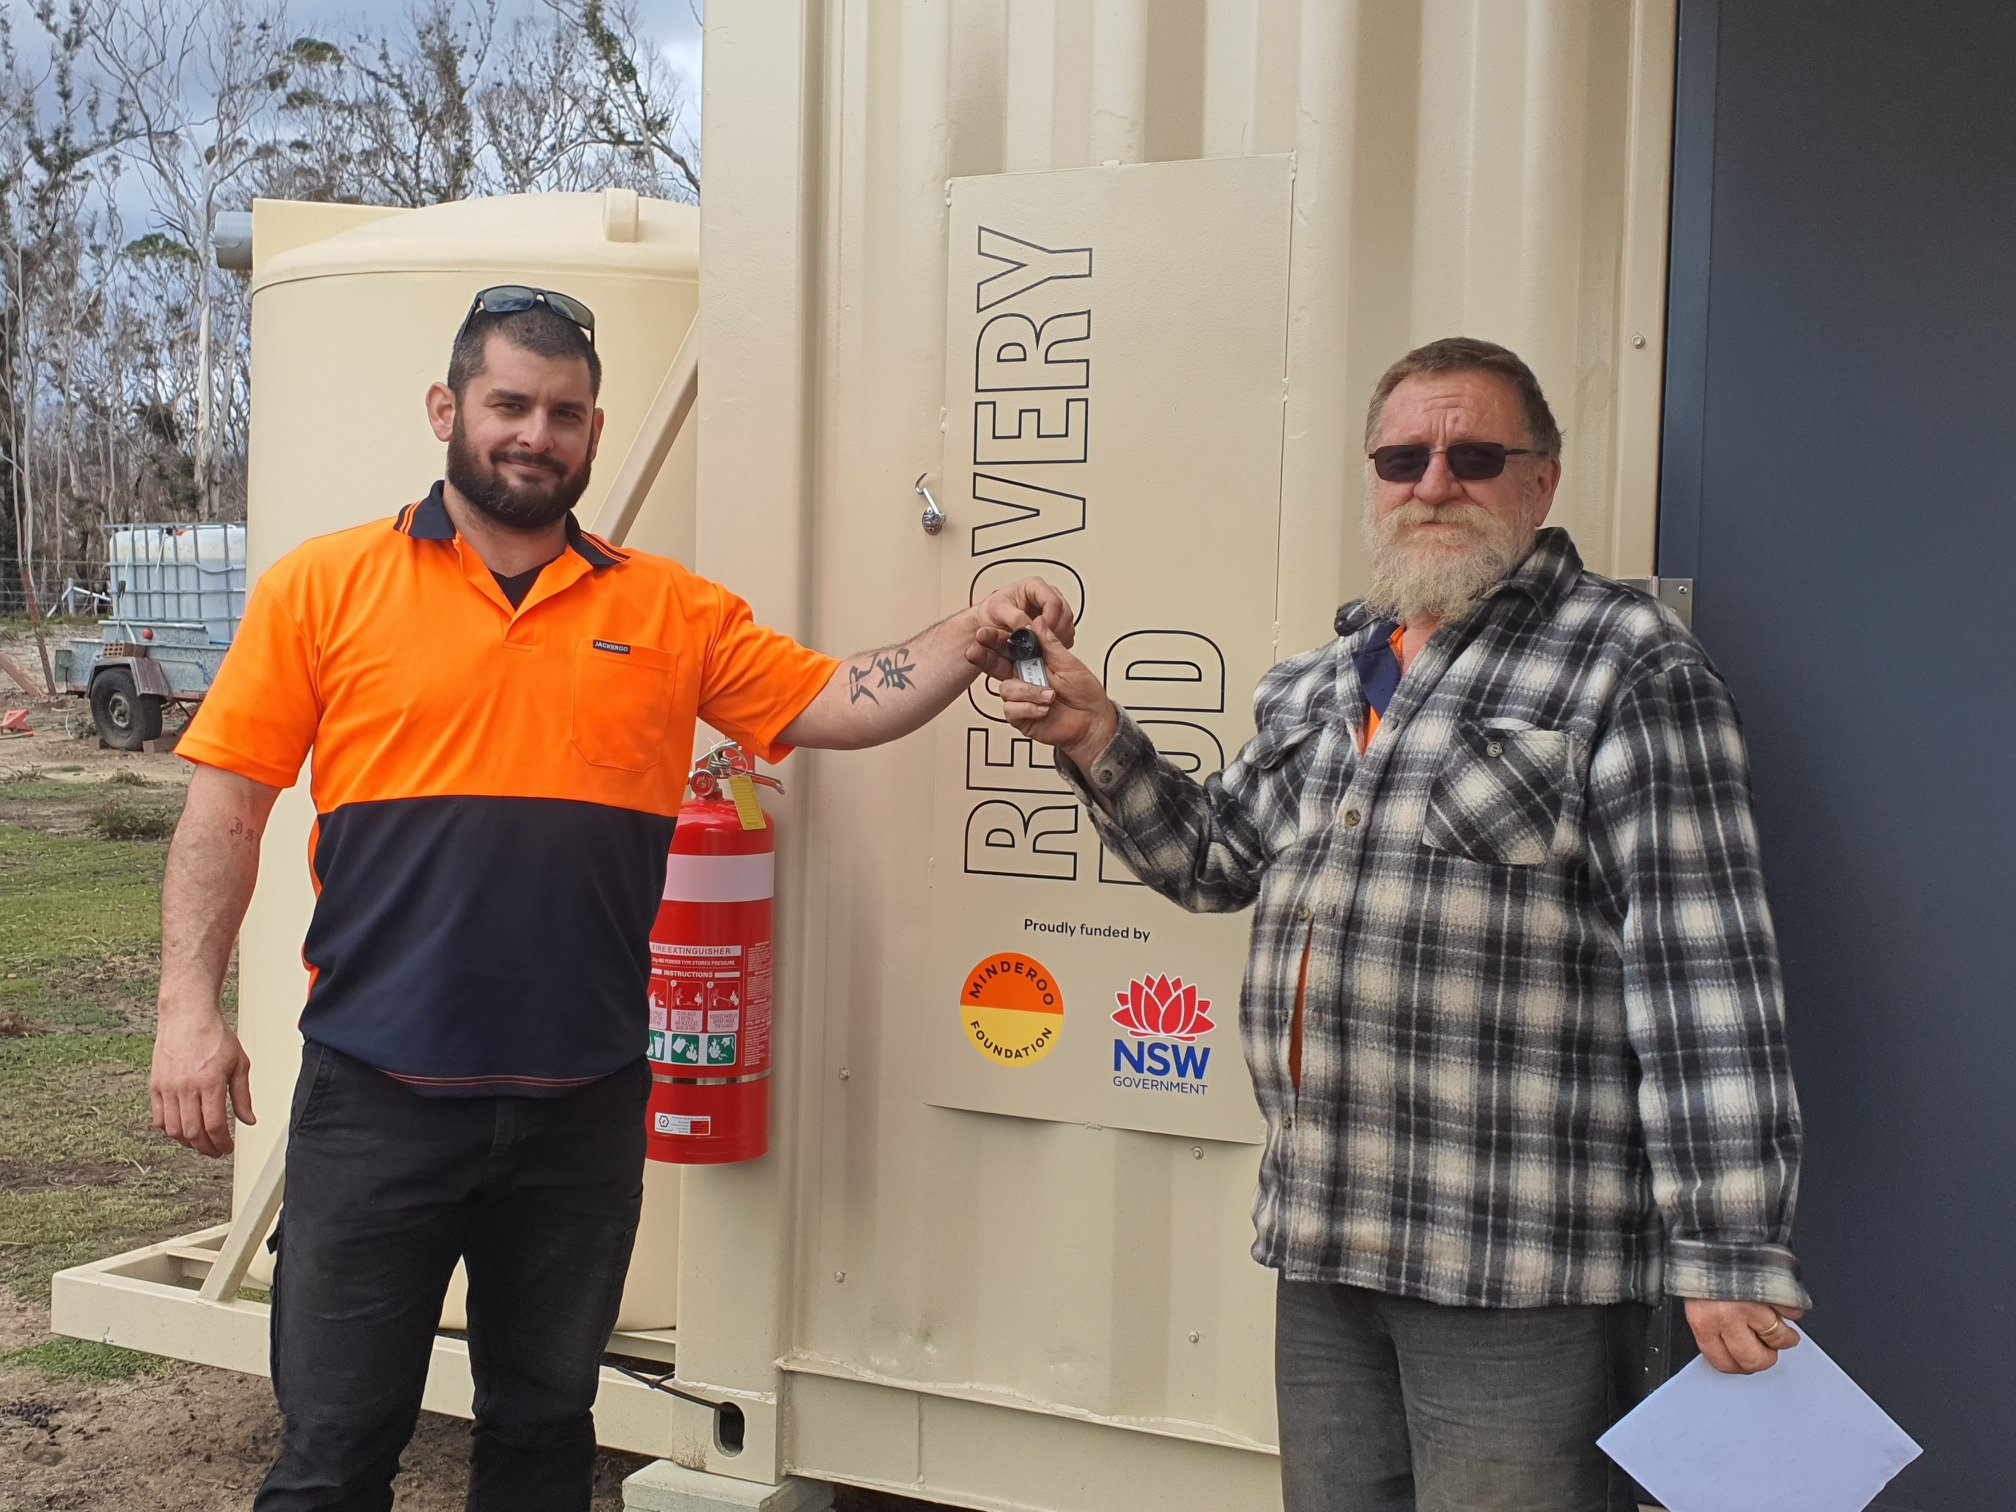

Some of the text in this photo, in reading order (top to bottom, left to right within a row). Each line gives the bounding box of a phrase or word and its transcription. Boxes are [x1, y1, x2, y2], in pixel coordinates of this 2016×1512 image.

[595, 641, 629, 652] JACKEROO
[1024, 918, 1150, 943] Proudly funded by
[652, 944, 731, 955] FIRE EXTINGUISHER
[663, 970, 713, 978] INSTRUCTIONS
[969, 960, 1055, 1006] MINDEROO
[970, 1020, 1053, 1060] FOUNDATION
[1113, 1039, 1211, 1080] NSW
[1112, 1075, 1208, 1096] GOVERNMENT
